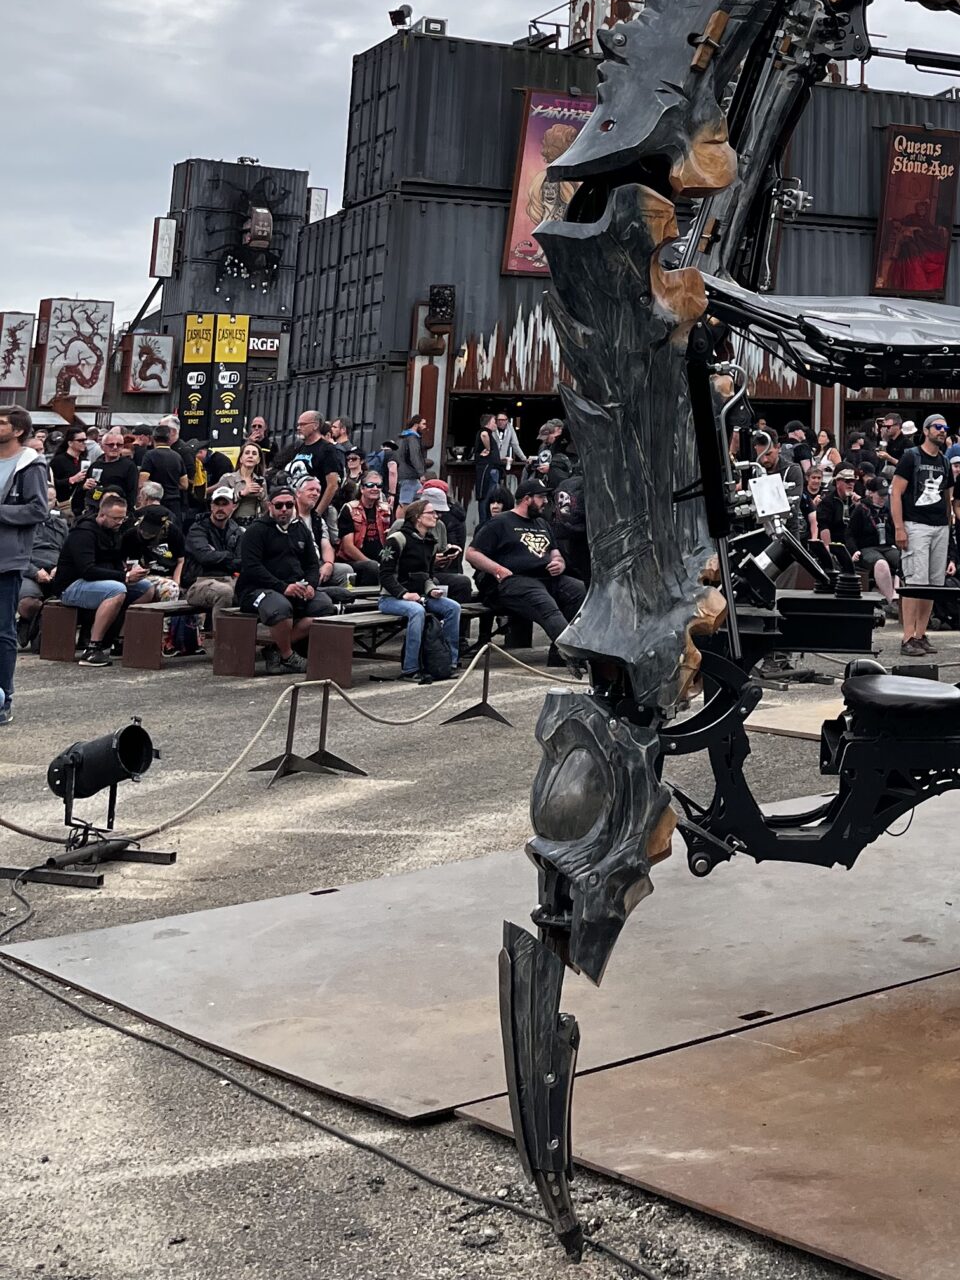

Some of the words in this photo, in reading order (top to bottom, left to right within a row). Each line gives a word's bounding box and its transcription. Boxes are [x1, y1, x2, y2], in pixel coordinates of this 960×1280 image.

[894, 135, 942, 157] Queens
[891, 156, 928, 174] Stone
[927, 160, 954, 180] Age
[186, 329, 211, 342] CASHLESS
[217, 328, 245, 342] CASHLESS
